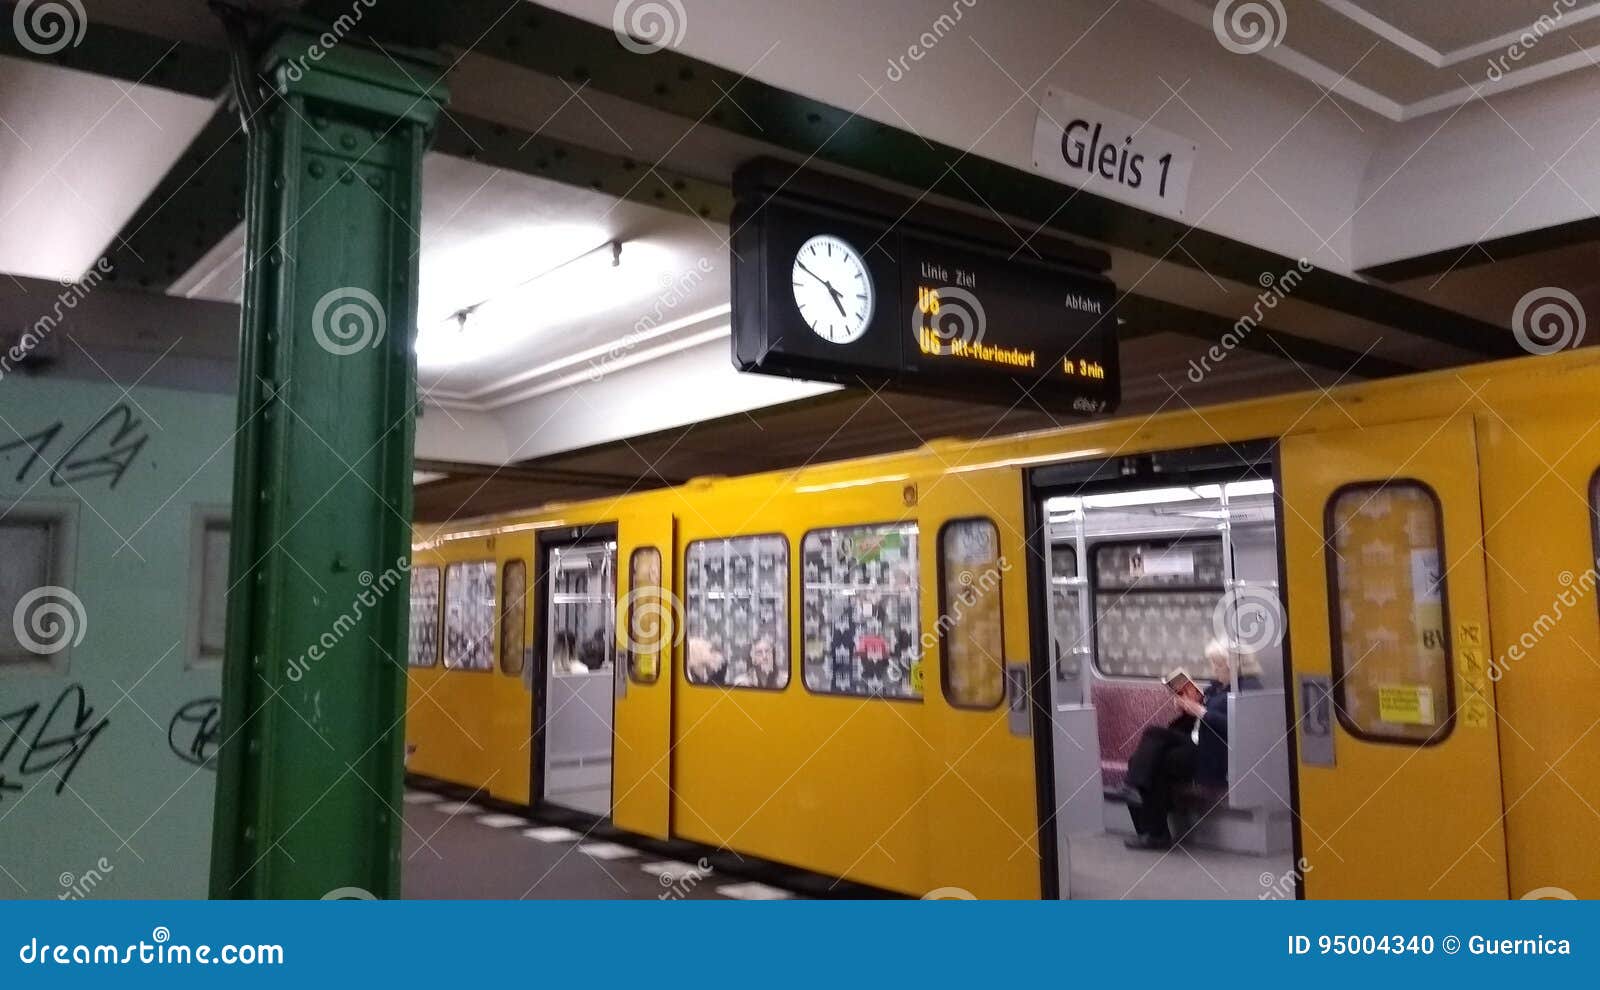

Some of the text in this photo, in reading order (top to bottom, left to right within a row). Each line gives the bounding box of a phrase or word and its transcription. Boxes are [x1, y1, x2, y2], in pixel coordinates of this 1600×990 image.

[1061, 119, 1172, 198] Gleis 1
[921, 262, 976, 288] Linie Ziel
[918, 286, 940, 315] U6
[1065, 293, 1102, 314] Abfahrt
[919, 327, 941, 355] U6
[951, 337, 1035, 368] Alt-Mariendorf
[1064, 356, 1074, 375] in
